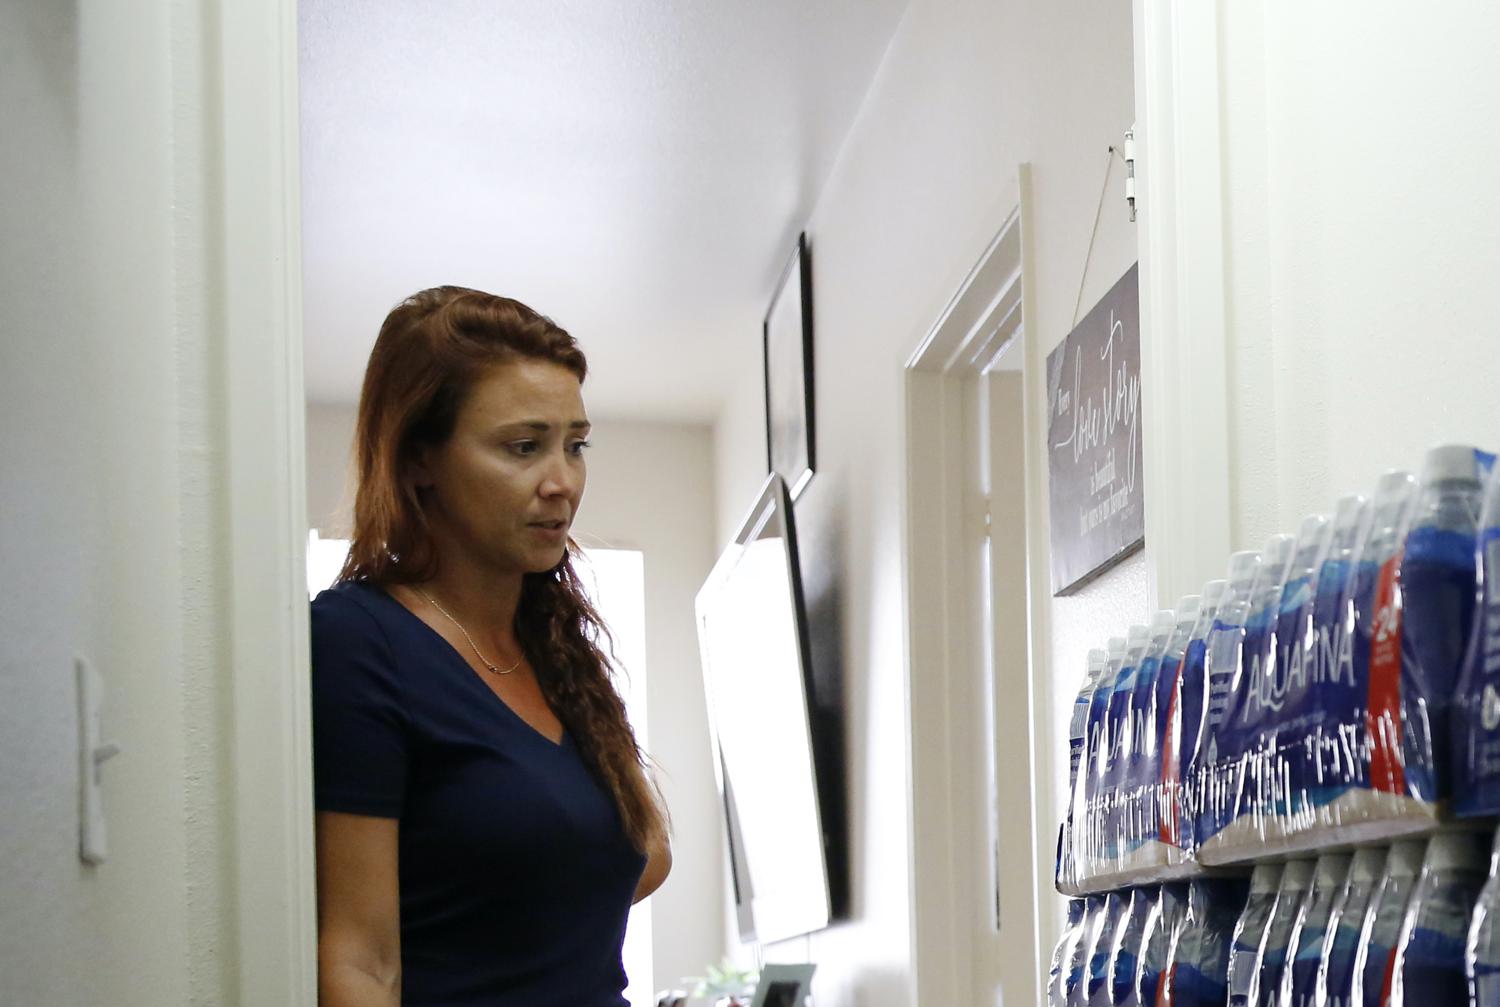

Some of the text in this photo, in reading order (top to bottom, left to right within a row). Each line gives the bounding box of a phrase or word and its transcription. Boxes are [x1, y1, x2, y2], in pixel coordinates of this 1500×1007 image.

[1101, 309, 1141, 493] story
[1376, 604, 1399, 642] 24
[1242, 620, 1356, 723] AQUAFINA
[1086, 704, 1157, 779] AUAIN
